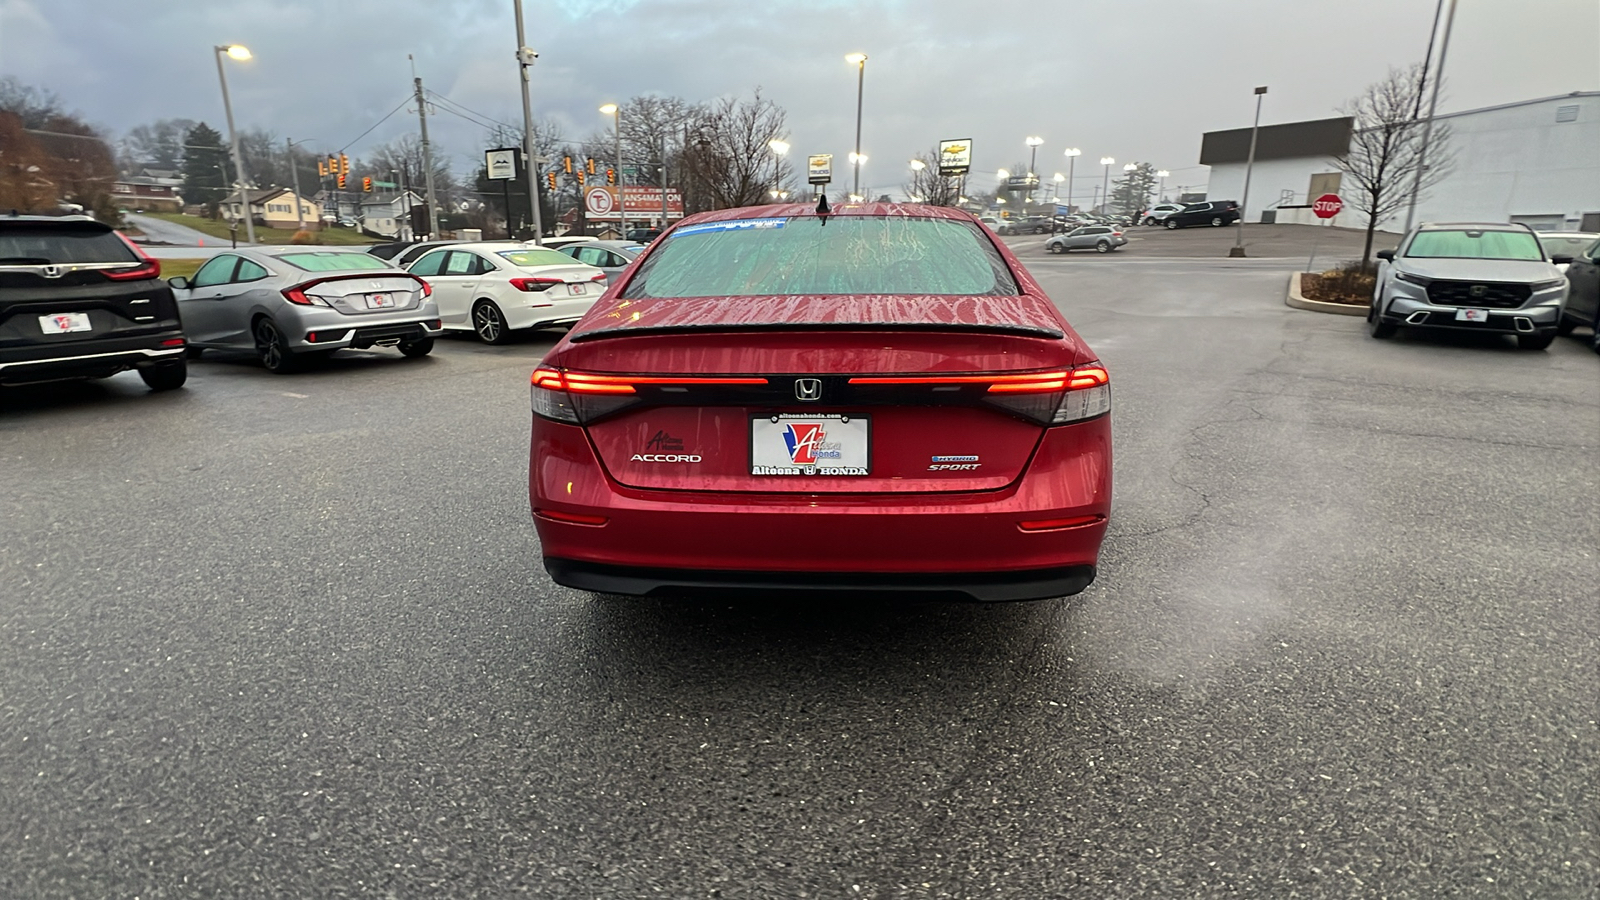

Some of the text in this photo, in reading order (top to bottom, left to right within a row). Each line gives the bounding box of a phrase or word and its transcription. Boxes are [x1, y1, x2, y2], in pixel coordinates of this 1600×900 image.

[613, 194, 681, 202] TANS4MATON
[1314, 201, 1341, 211] STOP
[630, 454, 702, 462] ACCORD
[811, 450, 840, 458] Honda
[752, 465, 800, 475] Altoona
[820, 467, 868, 475] HONDA
